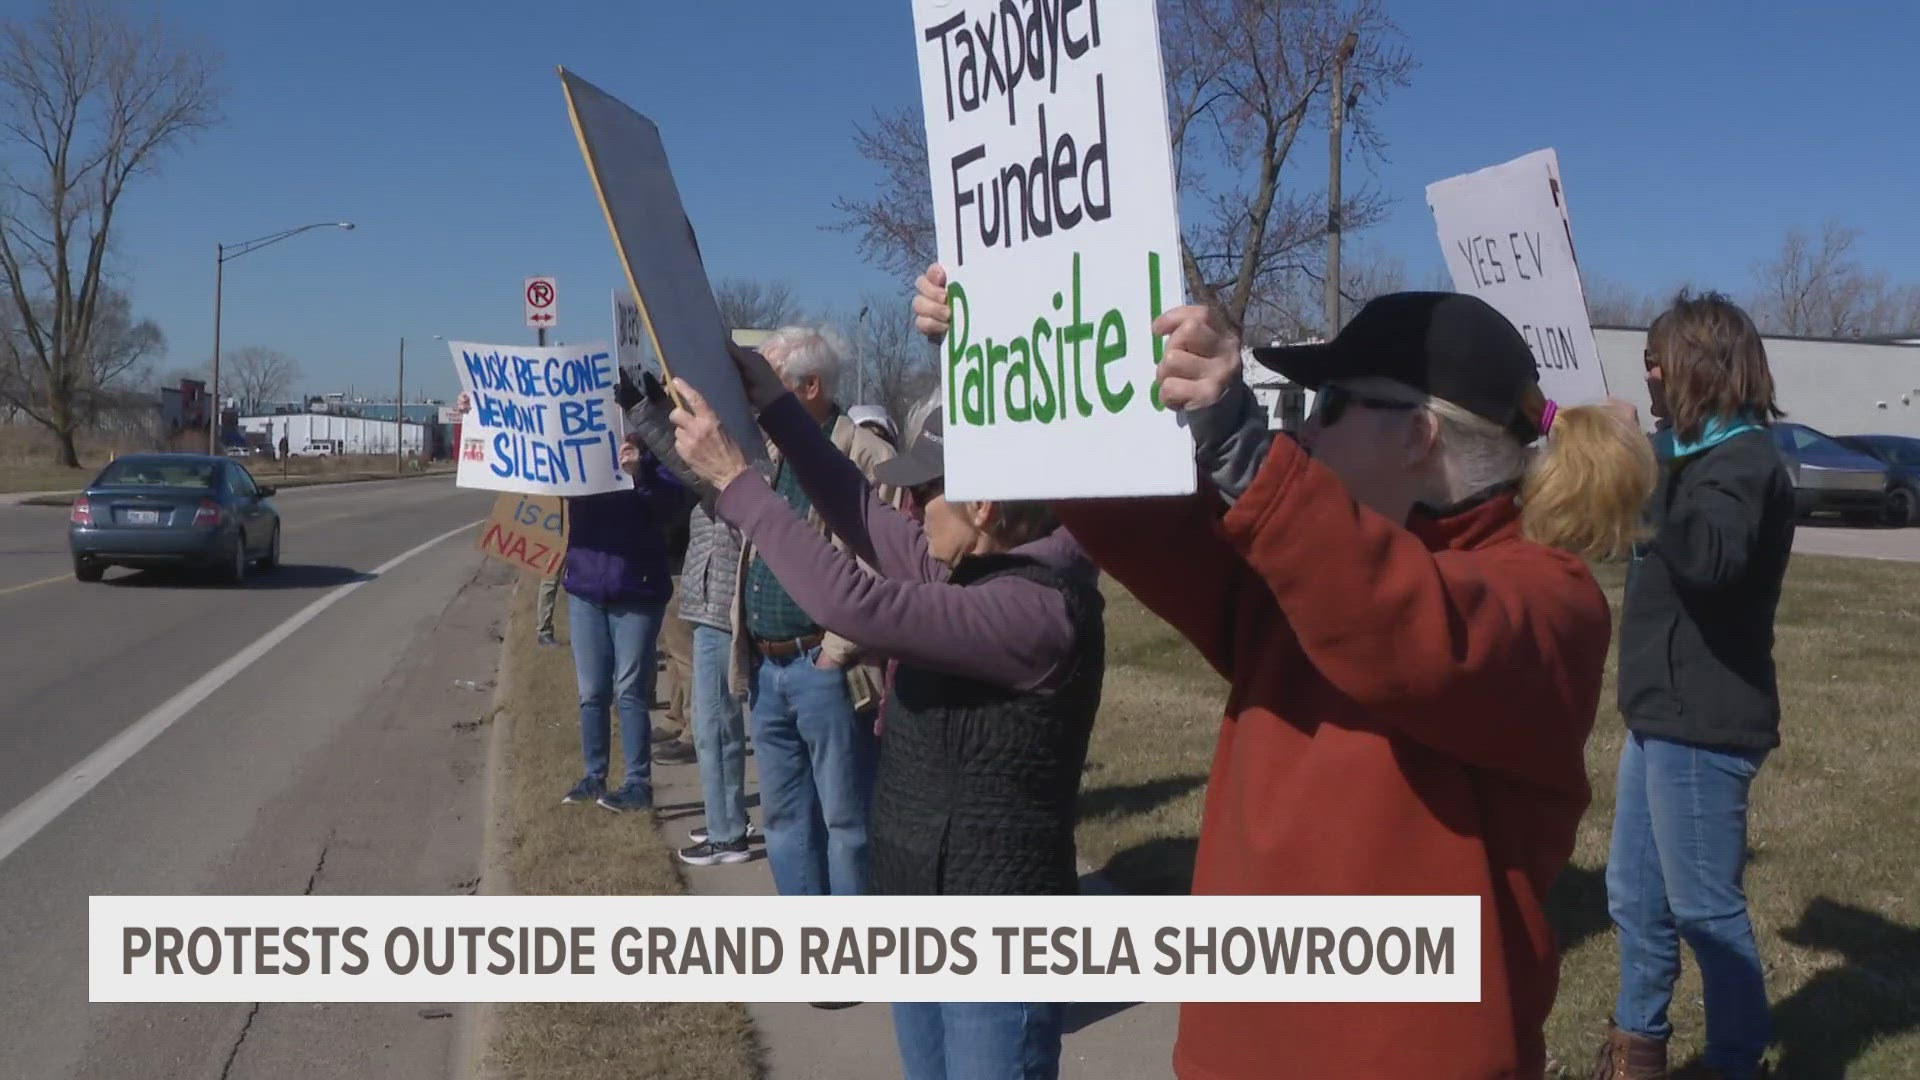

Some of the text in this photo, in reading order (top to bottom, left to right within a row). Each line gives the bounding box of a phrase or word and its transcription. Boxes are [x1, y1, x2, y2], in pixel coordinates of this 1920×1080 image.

[951, 73, 1112, 266] Funded
[1457, 231, 1543, 288] YES EV
[463, 350, 514, 393] MUSK
[559, 398, 607, 436] BE
[514, 496, 542, 526] is
[483, 523, 561, 575] NAZI
